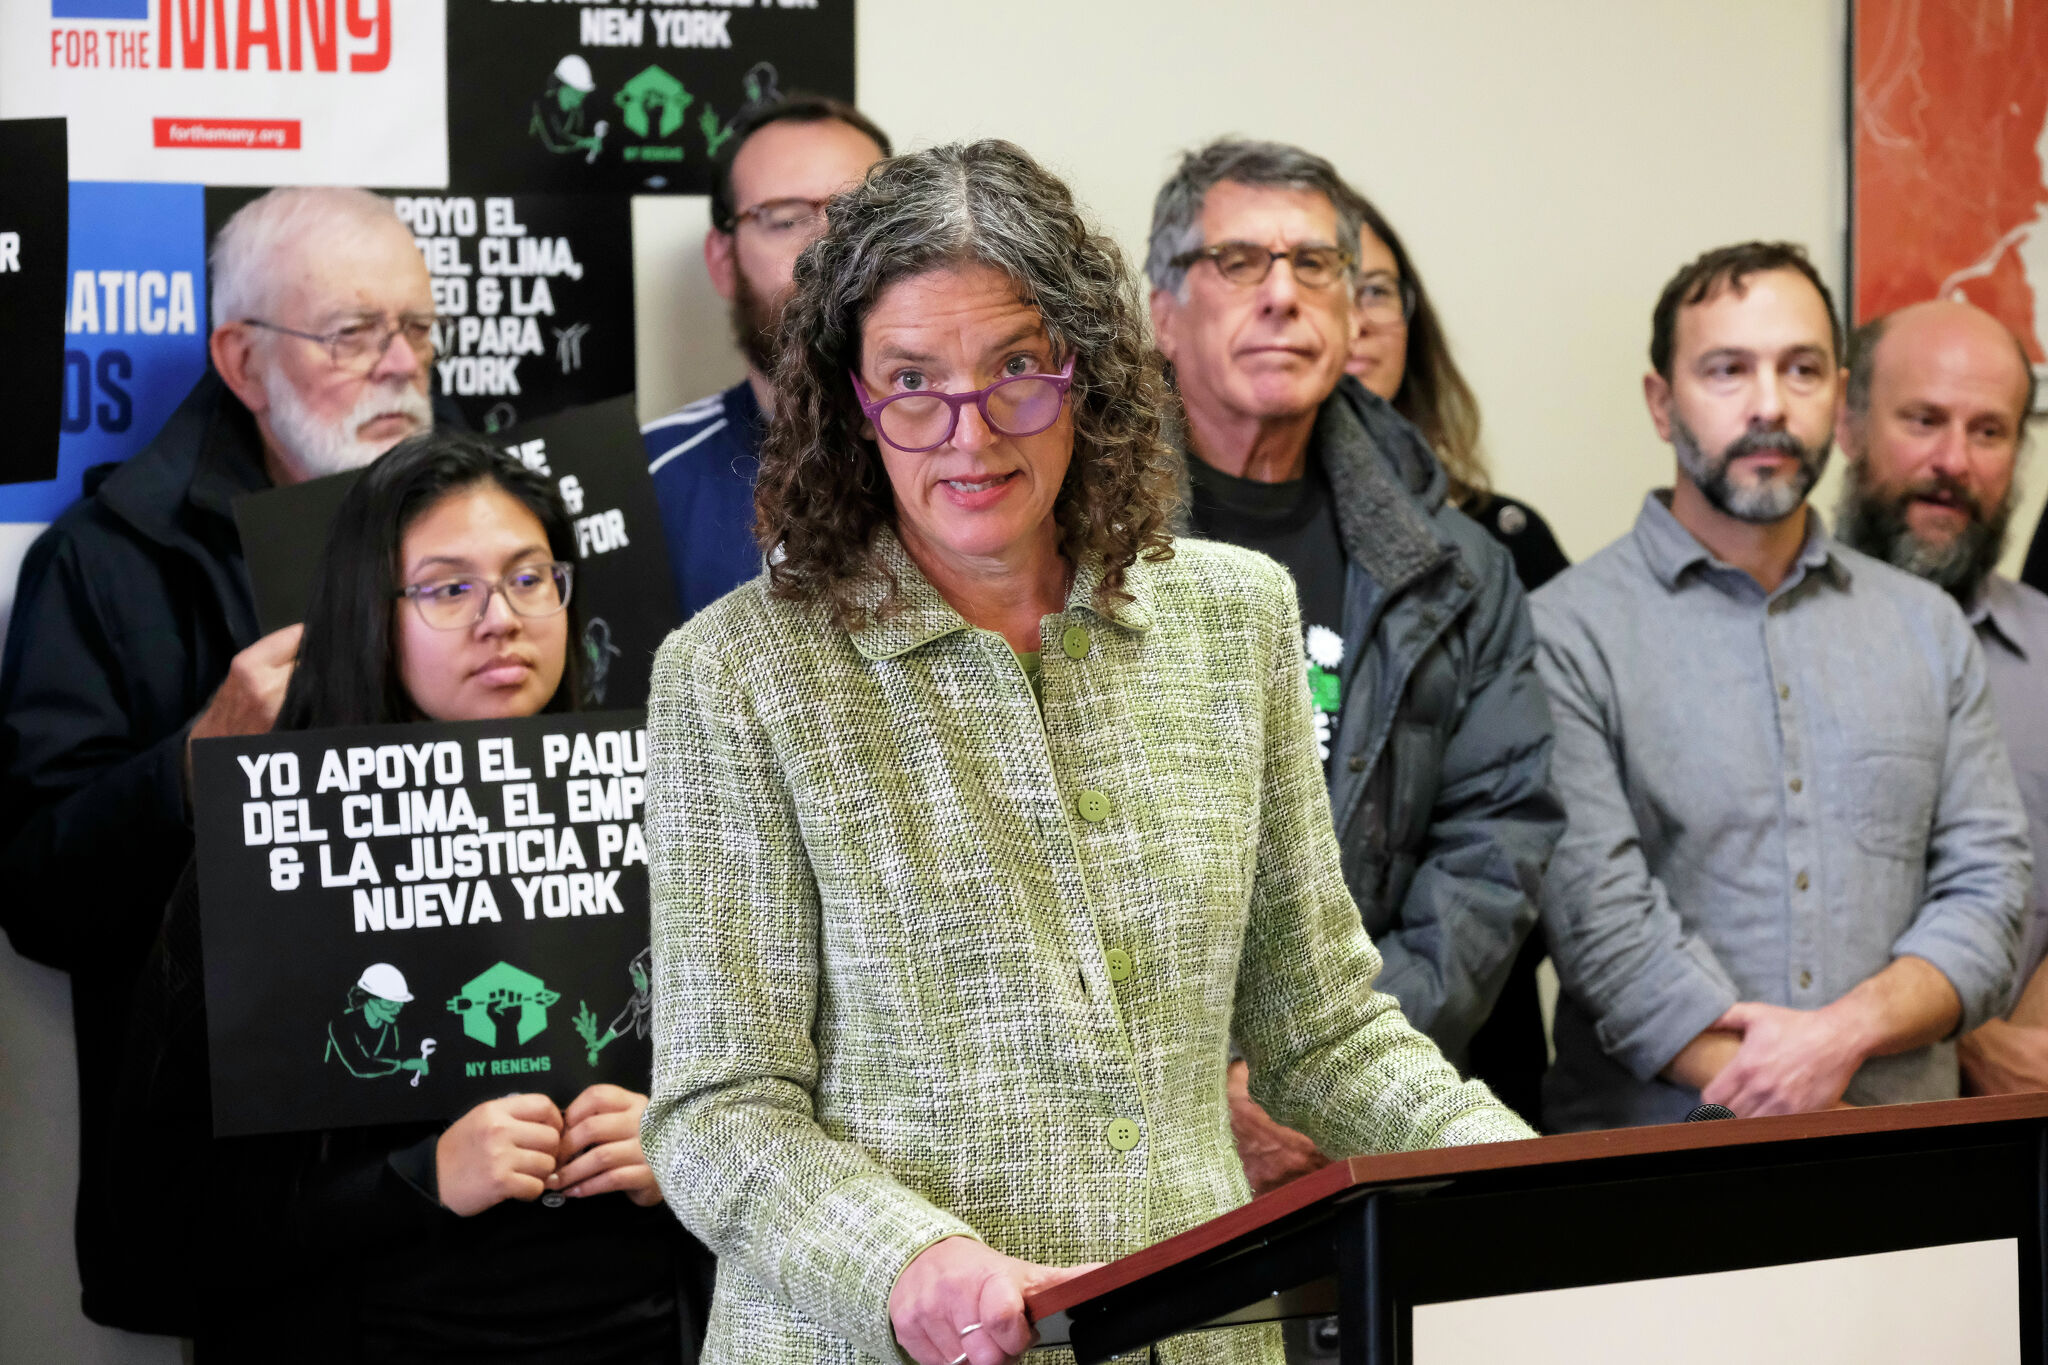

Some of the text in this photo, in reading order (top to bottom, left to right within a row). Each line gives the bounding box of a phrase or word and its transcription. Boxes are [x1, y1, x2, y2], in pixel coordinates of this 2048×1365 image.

[580, 8, 732, 47] NEW YORK
[51, 30, 99, 68] FOR
[105, 31, 150, 69] THE
[169, 124, 286, 146] forthemany.org
[484, 197, 527, 236] EL
[478, 237, 583, 281] CLIMA,
[65, 270, 197, 335] ATICA
[476, 277, 503, 316] &
[510, 277, 555, 316] LA
[459, 317, 544, 355] PARA
[437, 356, 521, 395] YORK
[574, 508, 630, 558] FOR
[237, 730, 646, 798] YO APOYO EL PAQU
[243, 799, 328, 846] DEL
[342, 787, 489, 834] CLIMA,
[502, 783, 555, 827] EL
[269, 822, 649, 891] & LA JUSTICIA PA
[353, 870, 624, 932] NUEVA YORK
[465, 1056, 551, 1077] NY RENEWS
